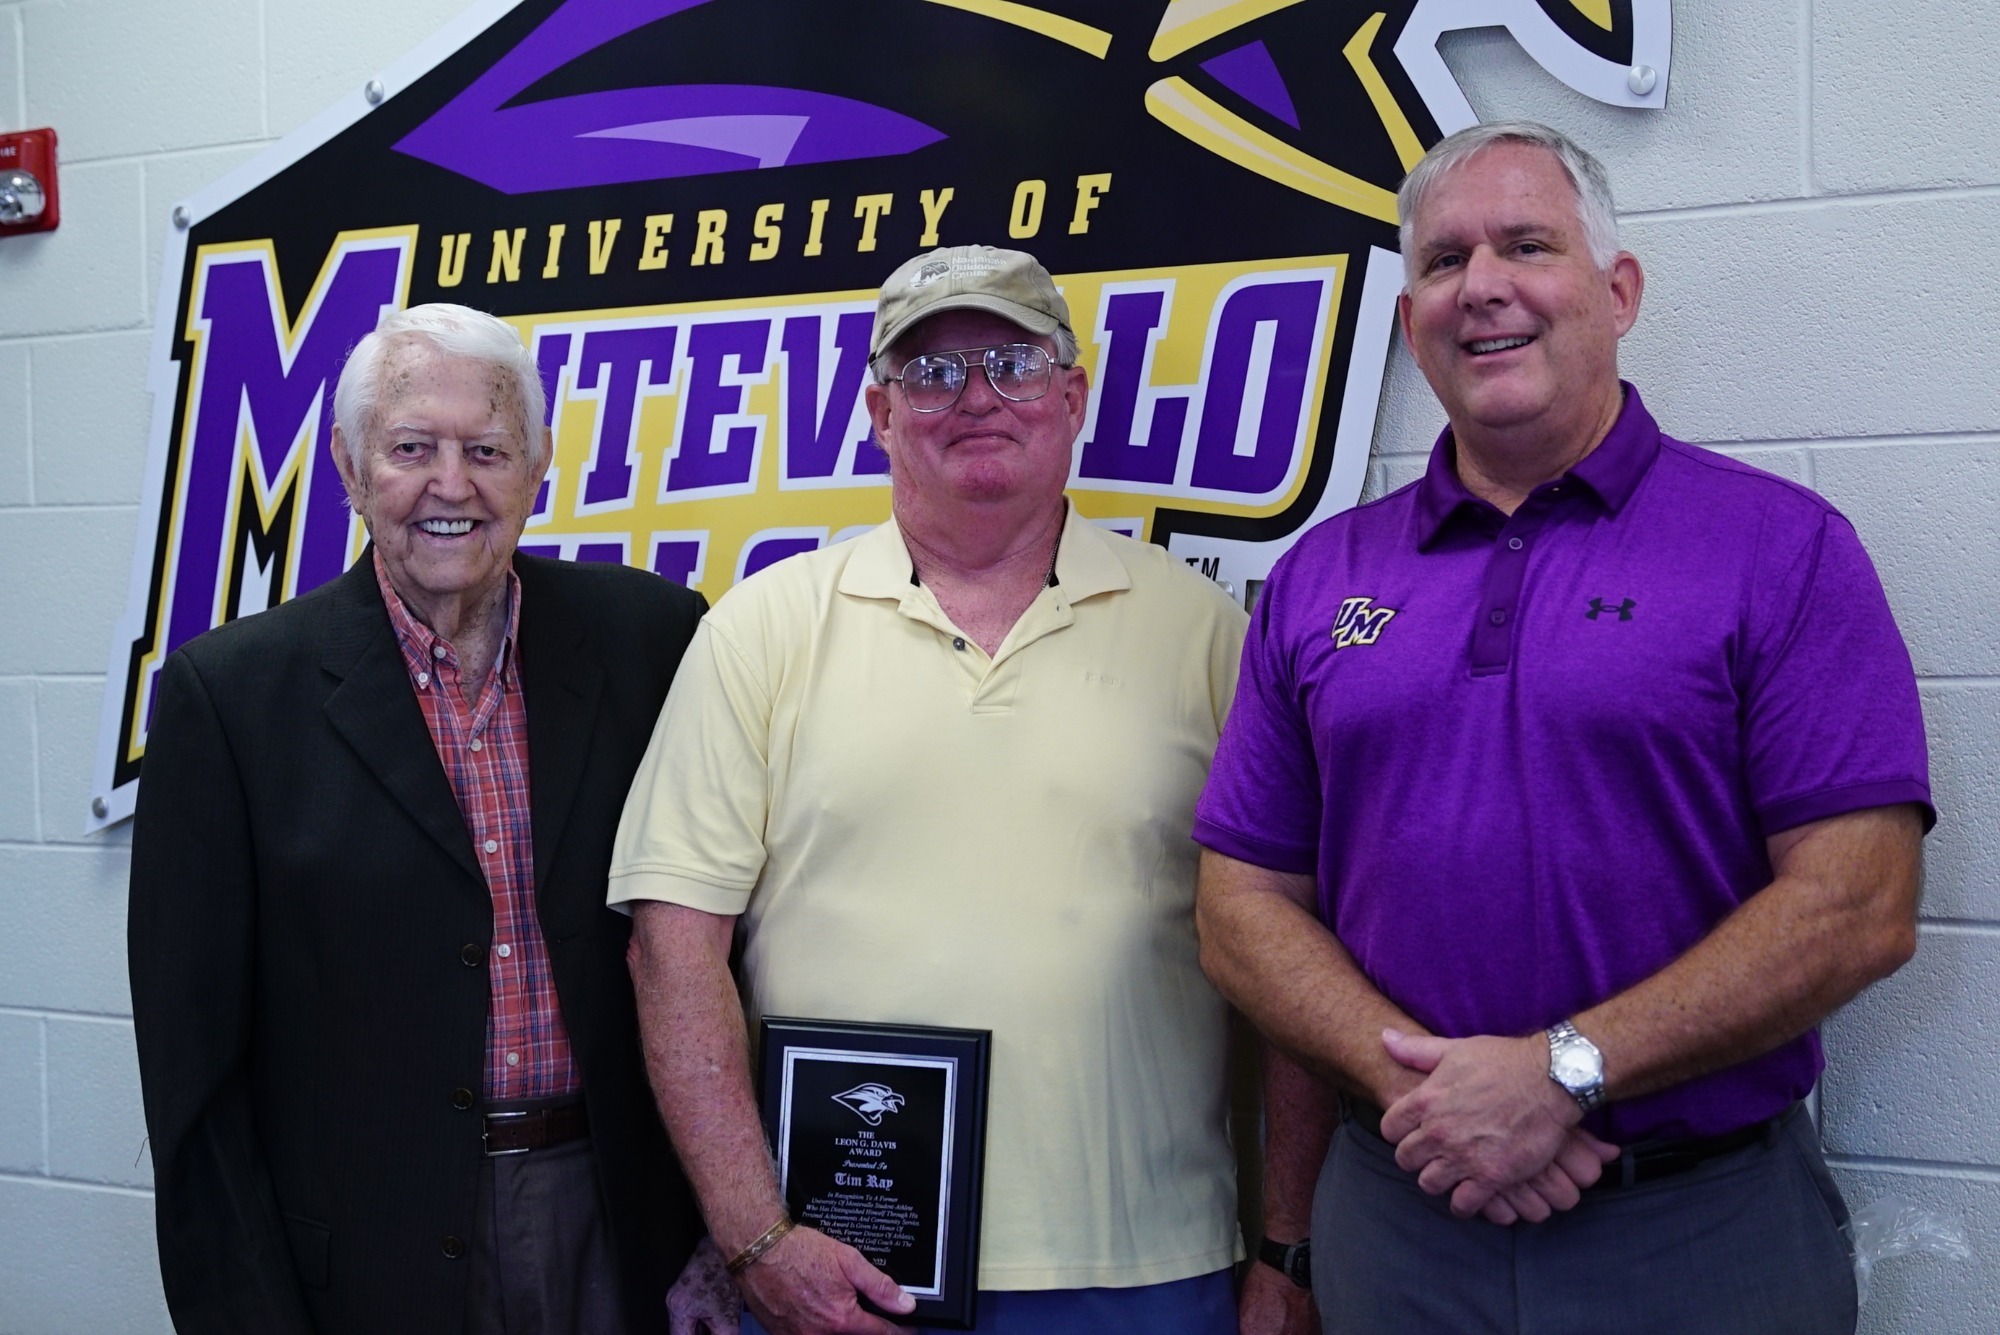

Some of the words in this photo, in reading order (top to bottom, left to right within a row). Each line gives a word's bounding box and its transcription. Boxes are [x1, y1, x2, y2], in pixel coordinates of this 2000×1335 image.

[437, 186, 955, 287] UNIVERSITY
[1008, 172, 1113, 239] OF
[952, 264, 994, 272] Outdoor
[951, 271, 988, 280] Center
[1331, 596, 1397, 649] UM
[858, 1131, 875, 1139] THE
[835, 1138, 858, 1147] LEON
[860, 1140, 869, 1148] G.
[871, 1141, 897, 1150] DAVIS
[849, 1148, 882, 1157] AWARD
[842, 1159, 876, 1170] Presented
[877, 1161, 888, 1170] To
[834, 1172, 862, 1186] Tim
[865, 1174, 894, 1191] Ray
